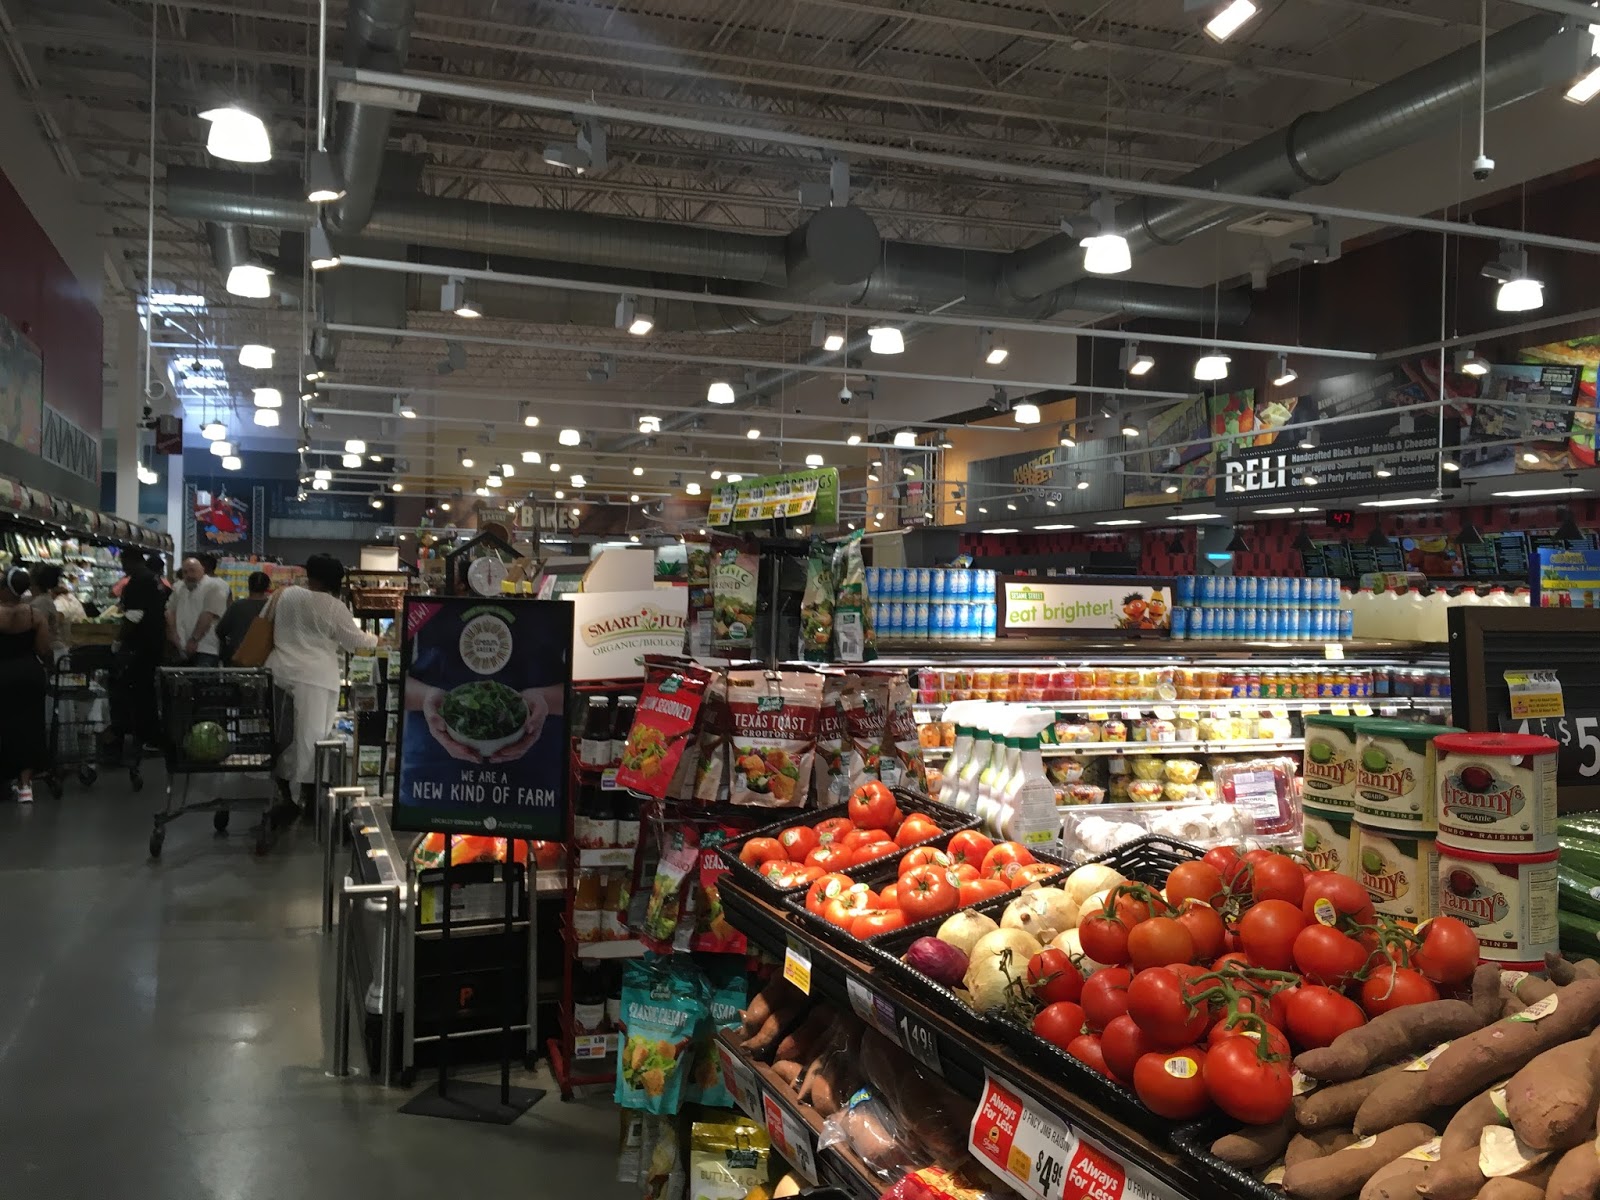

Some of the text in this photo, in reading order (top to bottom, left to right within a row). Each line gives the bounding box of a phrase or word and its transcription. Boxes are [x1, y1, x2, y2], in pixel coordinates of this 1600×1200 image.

[1291, 449, 1332, 463] Handcrafted
[1333, 447, 1352, 458] Black
[1372, 443, 1395, 454] Meats
[1396, 441, 1402, 450] &
[1404, 437, 1437, 449] Cheeses
[1225, 454, 1287, 493] DELI
[1328, 473, 1345, 483] Party
[1346, 470, 1372, 481] Platters
[1398, 465, 1435, 475] Occasions
[1333, 512, 1351, 523] 47
[1011, 591, 1043, 600] SESAME STREET
[407, 602, 430, 631] NEW!
[1009, 598, 1114, 623] eat brighter!
[588, 614, 641, 638] SMART
[655, 698, 693, 721] SEASONED
[735, 712, 807, 731] TEXAS TOAST
[820, 717, 842, 732] TEX
[742, 729, 795, 739] CROUTONS
[461, 769, 508, 784] WE ARE A
[412, 781, 555, 807] NEW KIND OF FARM
[1374, 809, 1415, 820] RAISINS
[1479, 833, 1525, 841] RAISINS
[703, 854, 730, 870] SEAS
[1481, 940, 1509, 948] SINS
[629, 1002, 688, 1027] CLASSIC CAESAR
[709, 1002, 736, 1020] ESAR
[989, 1092, 1017, 1121] Always
[983, 1102, 1014, 1137] For Less.
[1027, 1112, 1041, 1129] FNCY
[1039, 1122, 1052, 1139] JMB
[1068, 1168, 1091, 1190] For
[1076, 1157, 1119, 1191] Always
